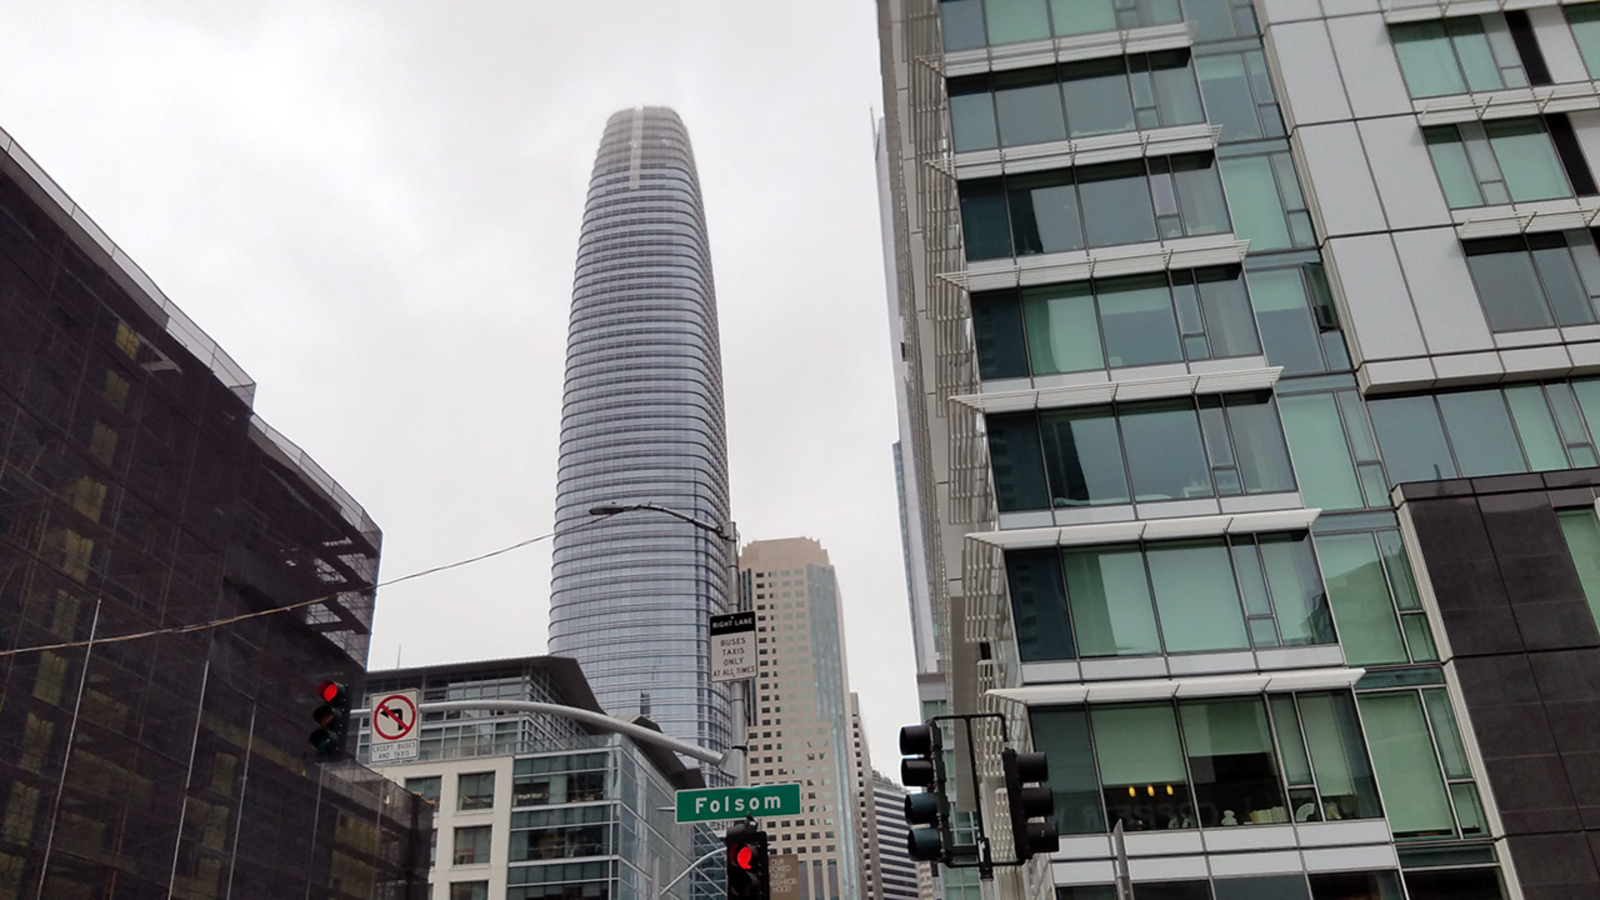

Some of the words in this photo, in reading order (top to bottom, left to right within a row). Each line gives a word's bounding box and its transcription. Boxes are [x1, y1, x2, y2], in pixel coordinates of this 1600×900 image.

[712, 620, 732, 628] RIGHT
[734, 617, 753, 625] LANE
[720, 637, 746, 647] BUSES
[722, 647, 745, 656] TAXIS
[723, 657, 744, 666] ONLY
[722, 668, 734, 676] ALL
[736, 665, 755, 674] TIMES
[372, 744, 393, 752] EXCEPT
[695, 795, 781, 815] Folsom
